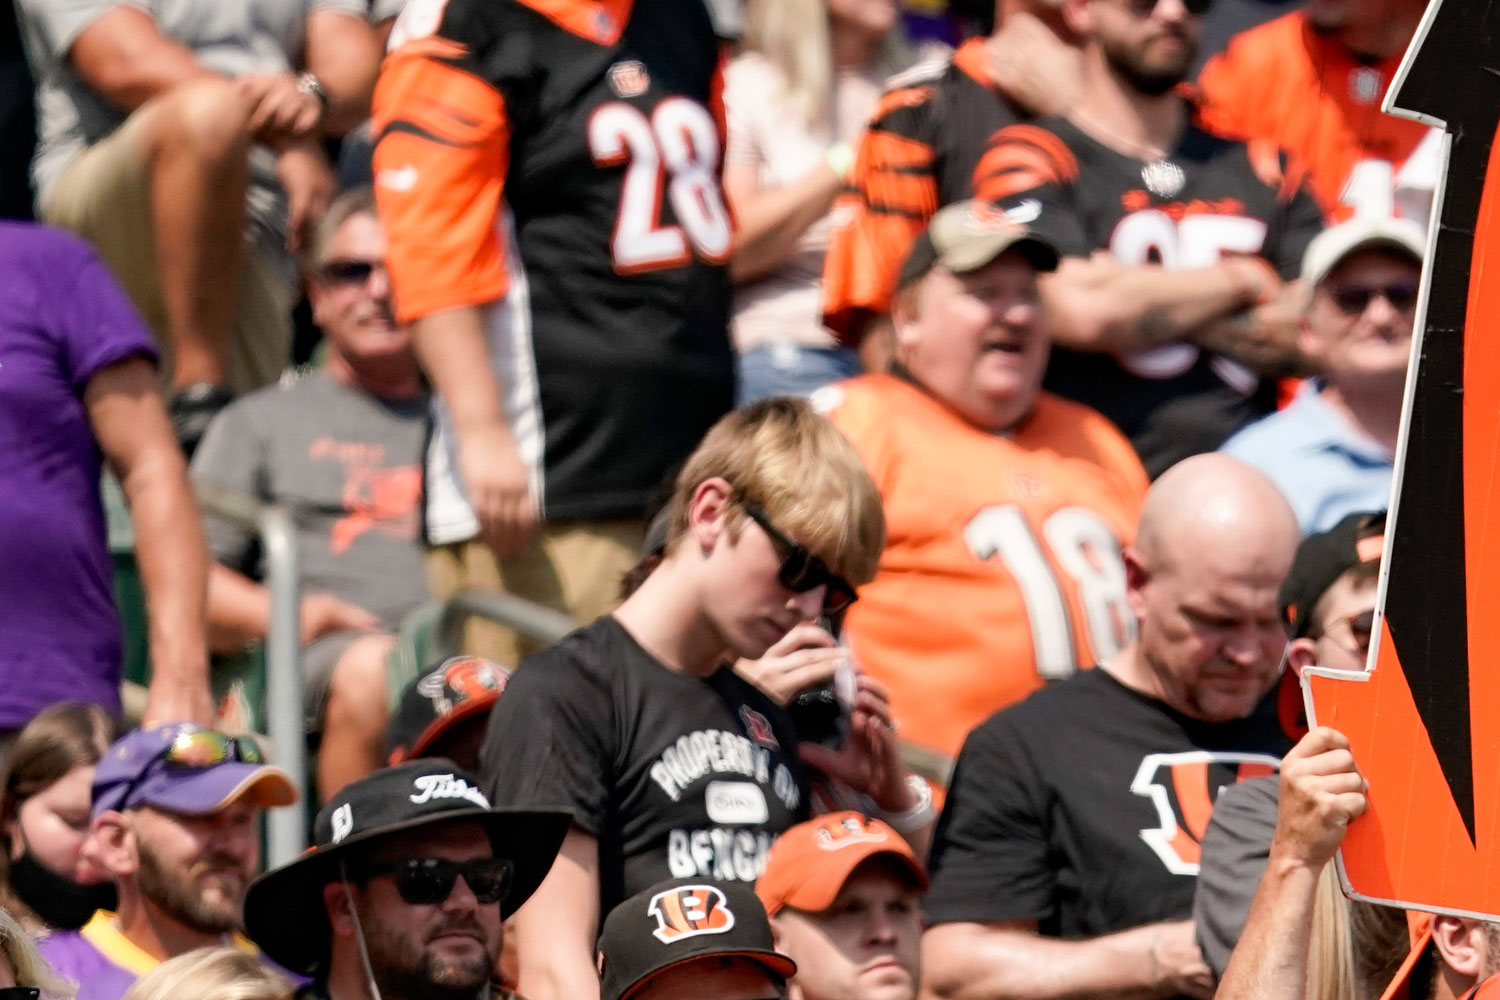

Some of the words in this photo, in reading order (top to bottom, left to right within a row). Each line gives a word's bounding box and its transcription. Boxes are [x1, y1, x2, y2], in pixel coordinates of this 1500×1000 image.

[587, 96, 740, 276] 28
[963, 503, 1141, 682] 18
[650, 728, 770, 802] PROPERTY
